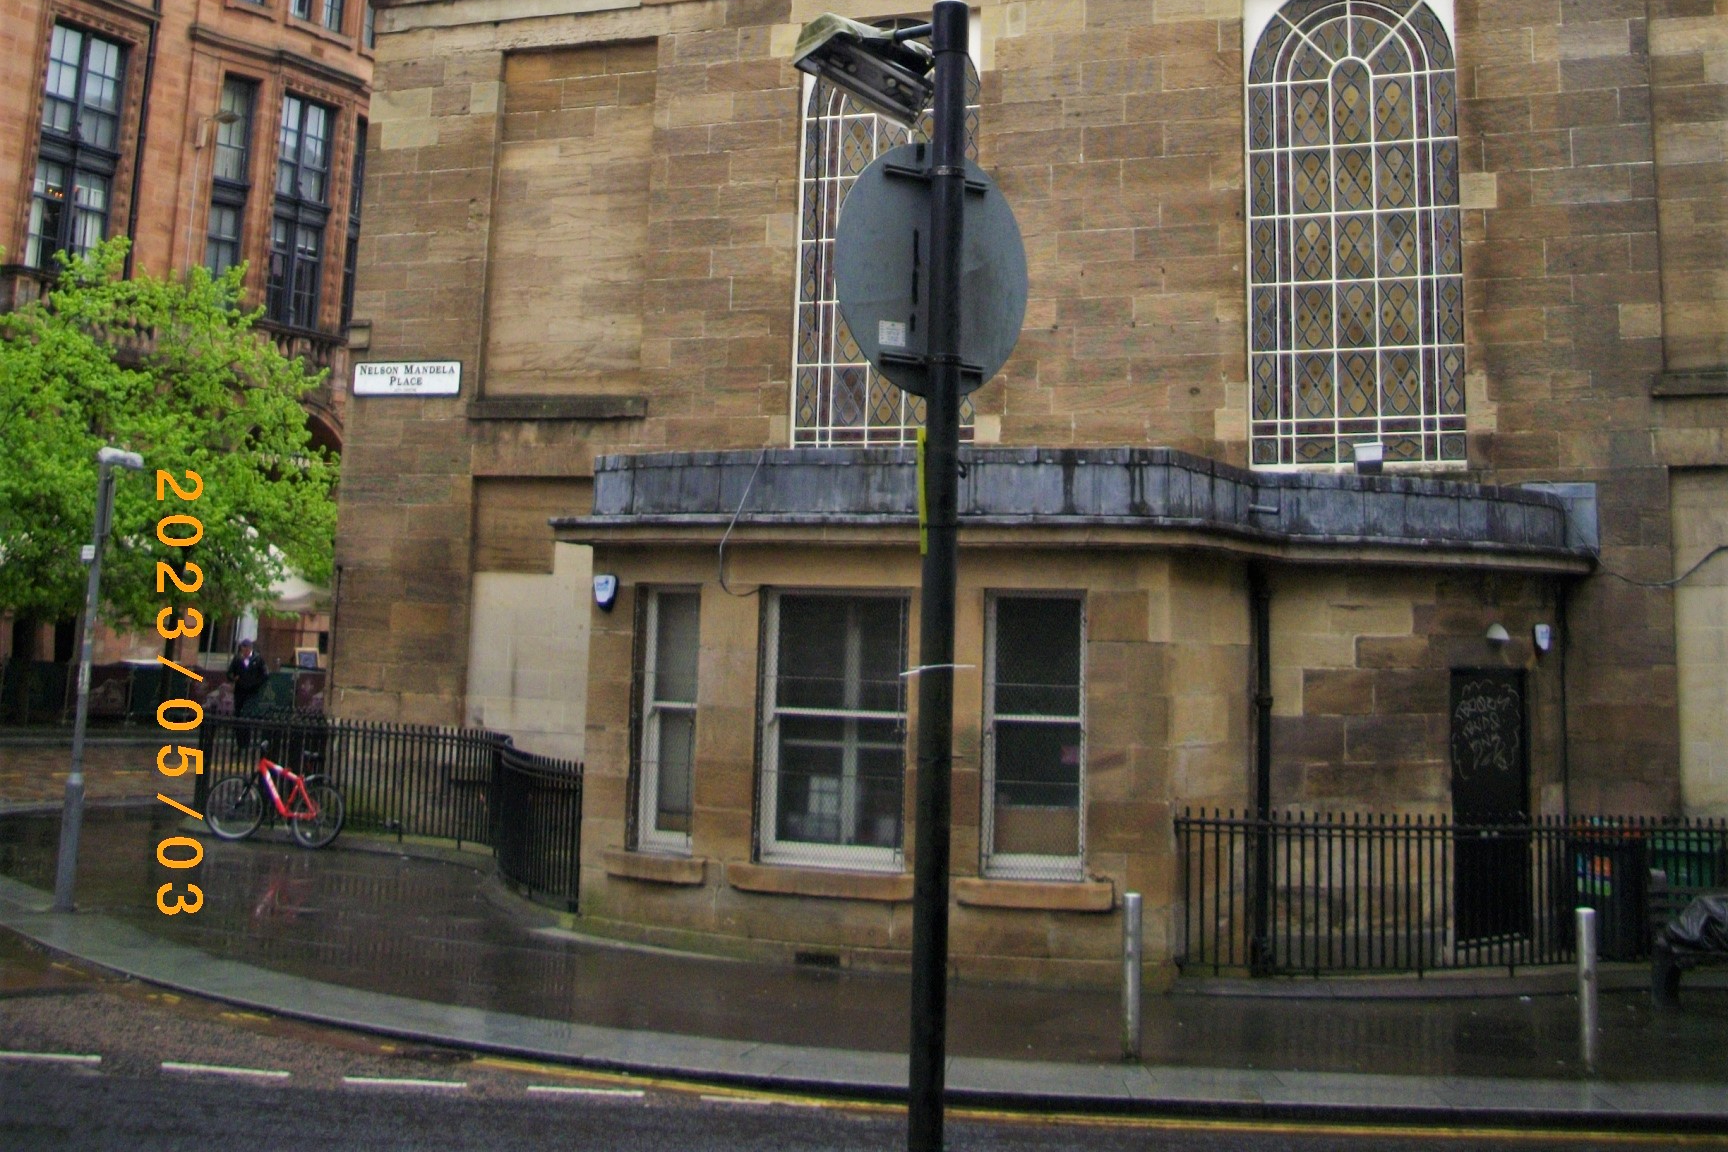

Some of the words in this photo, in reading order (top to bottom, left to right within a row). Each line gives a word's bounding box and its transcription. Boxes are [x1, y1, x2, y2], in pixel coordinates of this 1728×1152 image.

[360, 364, 399, 376] NELSON
[404, 364, 455, 375] MANDELA
[389, 375, 423, 386] PLACE
